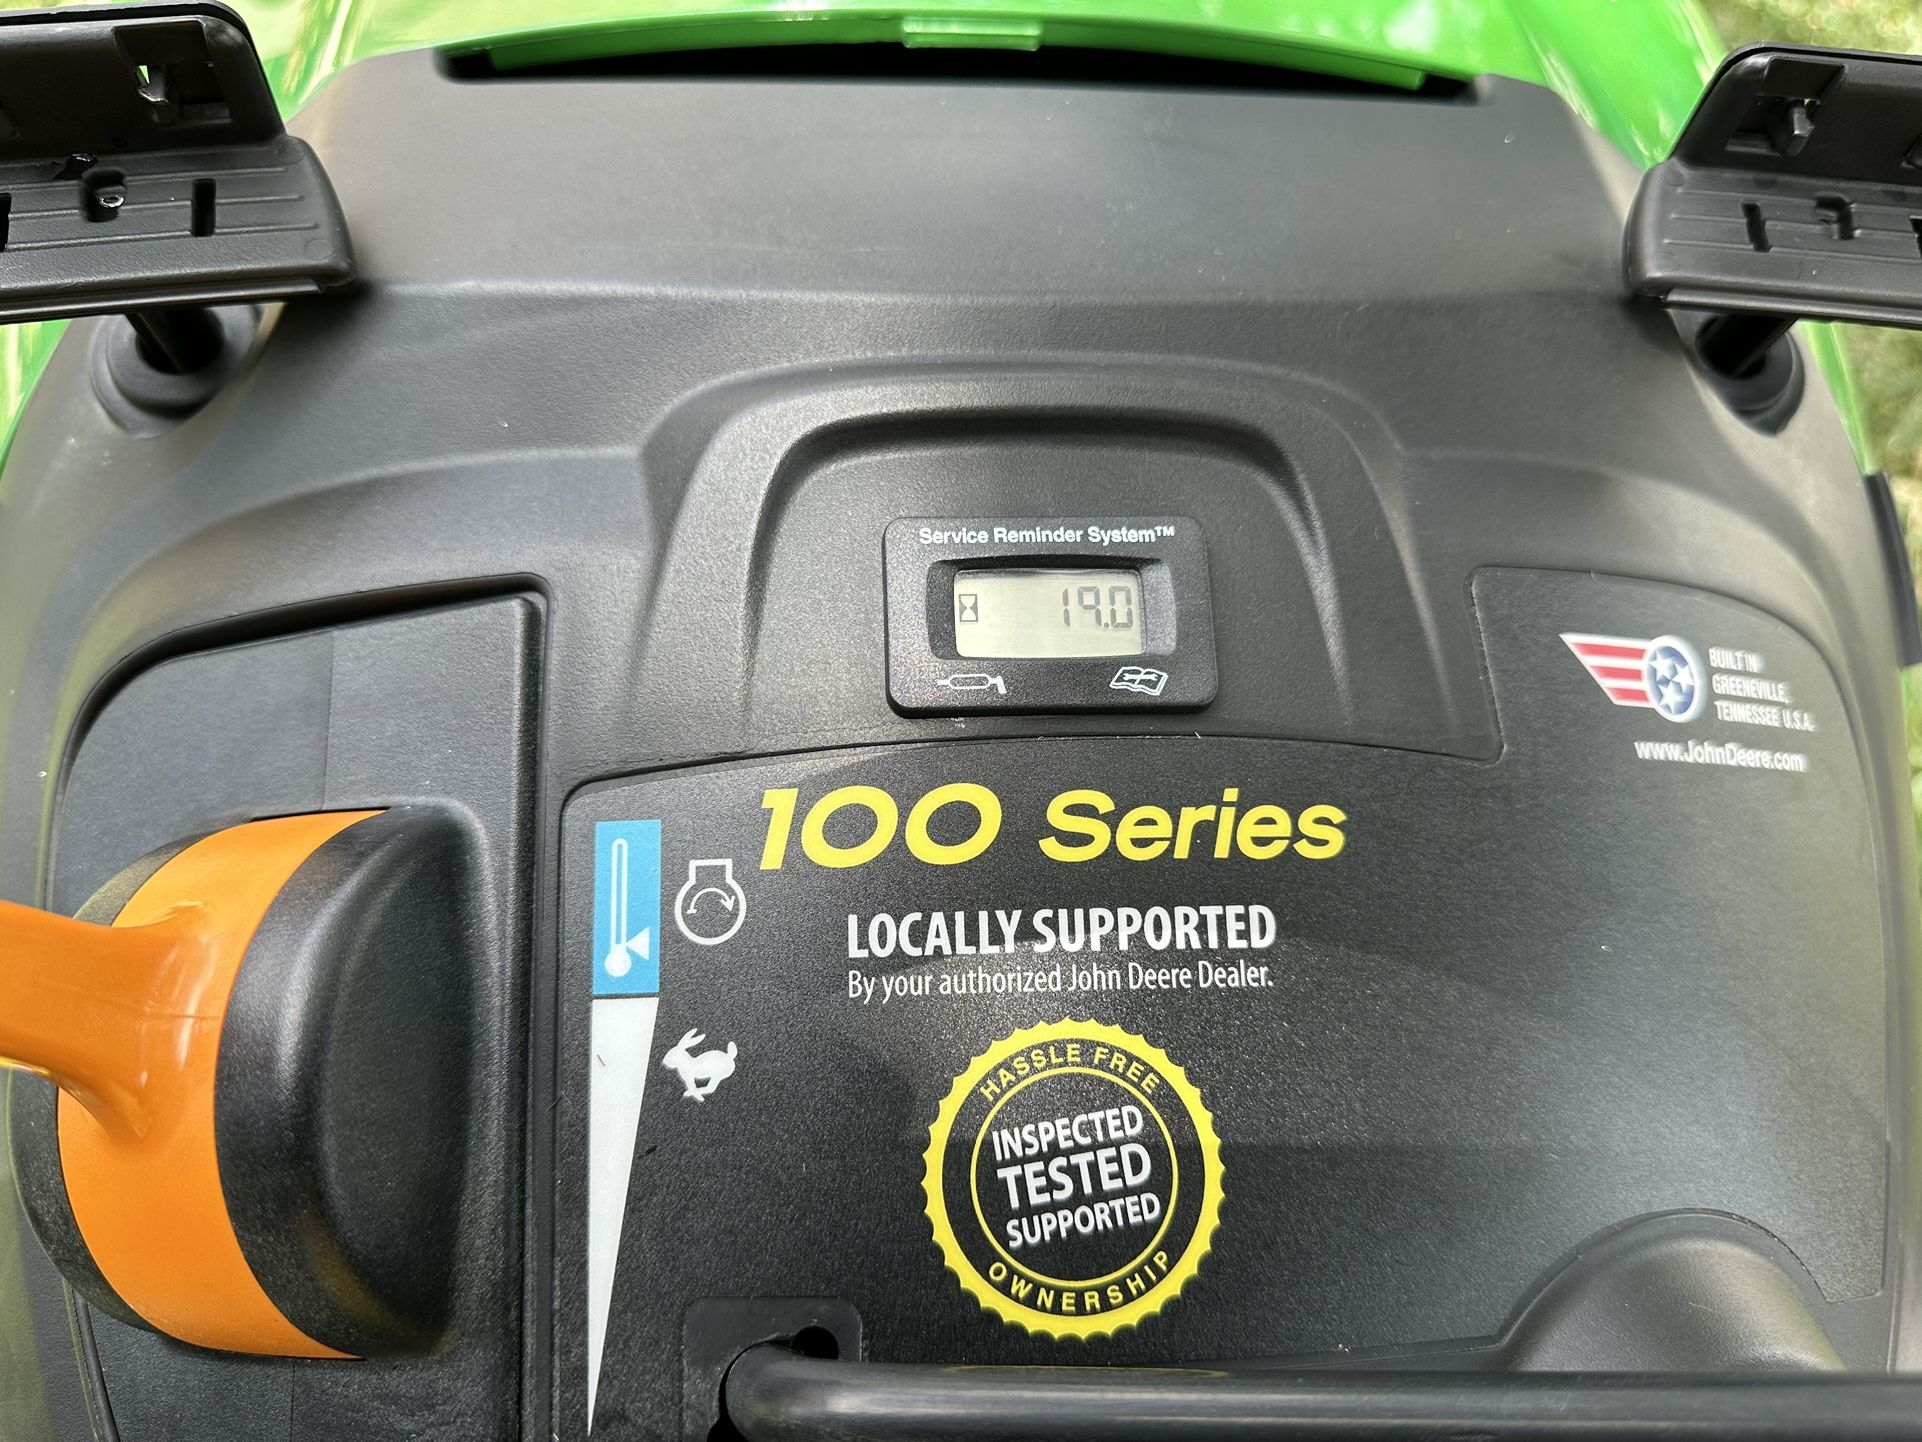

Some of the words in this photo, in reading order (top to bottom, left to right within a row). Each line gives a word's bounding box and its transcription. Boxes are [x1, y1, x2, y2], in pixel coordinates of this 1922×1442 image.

[919, 527, 989, 544] Service
[993, 526, 1083, 543] Reminder
[1061, 585, 1133, 629] 19.0
[1709, 647, 1744, 670] BUILT
[1744, 651, 1762, 673] IN
[1714, 700, 1782, 728] TENNESSEE
[1633, 738, 1808, 772] www.JohnDeere.com
[760, 782, 1002, 870] 100
[1039, 788, 1347, 862] Series
[847, 909, 1020, 959] LOCALLY
[1032, 905, 1276, 953] SUPPORTED
[848, 970, 875, 1004] By
[882, 974, 932, 1004] your
[940, 965, 1062, 994] authorized
[1065, 963, 1121, 993] John
[1128, 962, 1192, 990] Deere
[1199, 960, 1274, 988] Dealer.
[979, 1043, 1081, 1102] HASSLE
[1093, 1046, 1160, 1095] FREE
[992, 1105, 1143, 1161] INSPECTED
[996, 1142, 1151, 1210] TESTED
[1006, 1192, 1160, 1249] SUPPORTED
[988, 1250, 1169, 1312] OWNERSHIP
